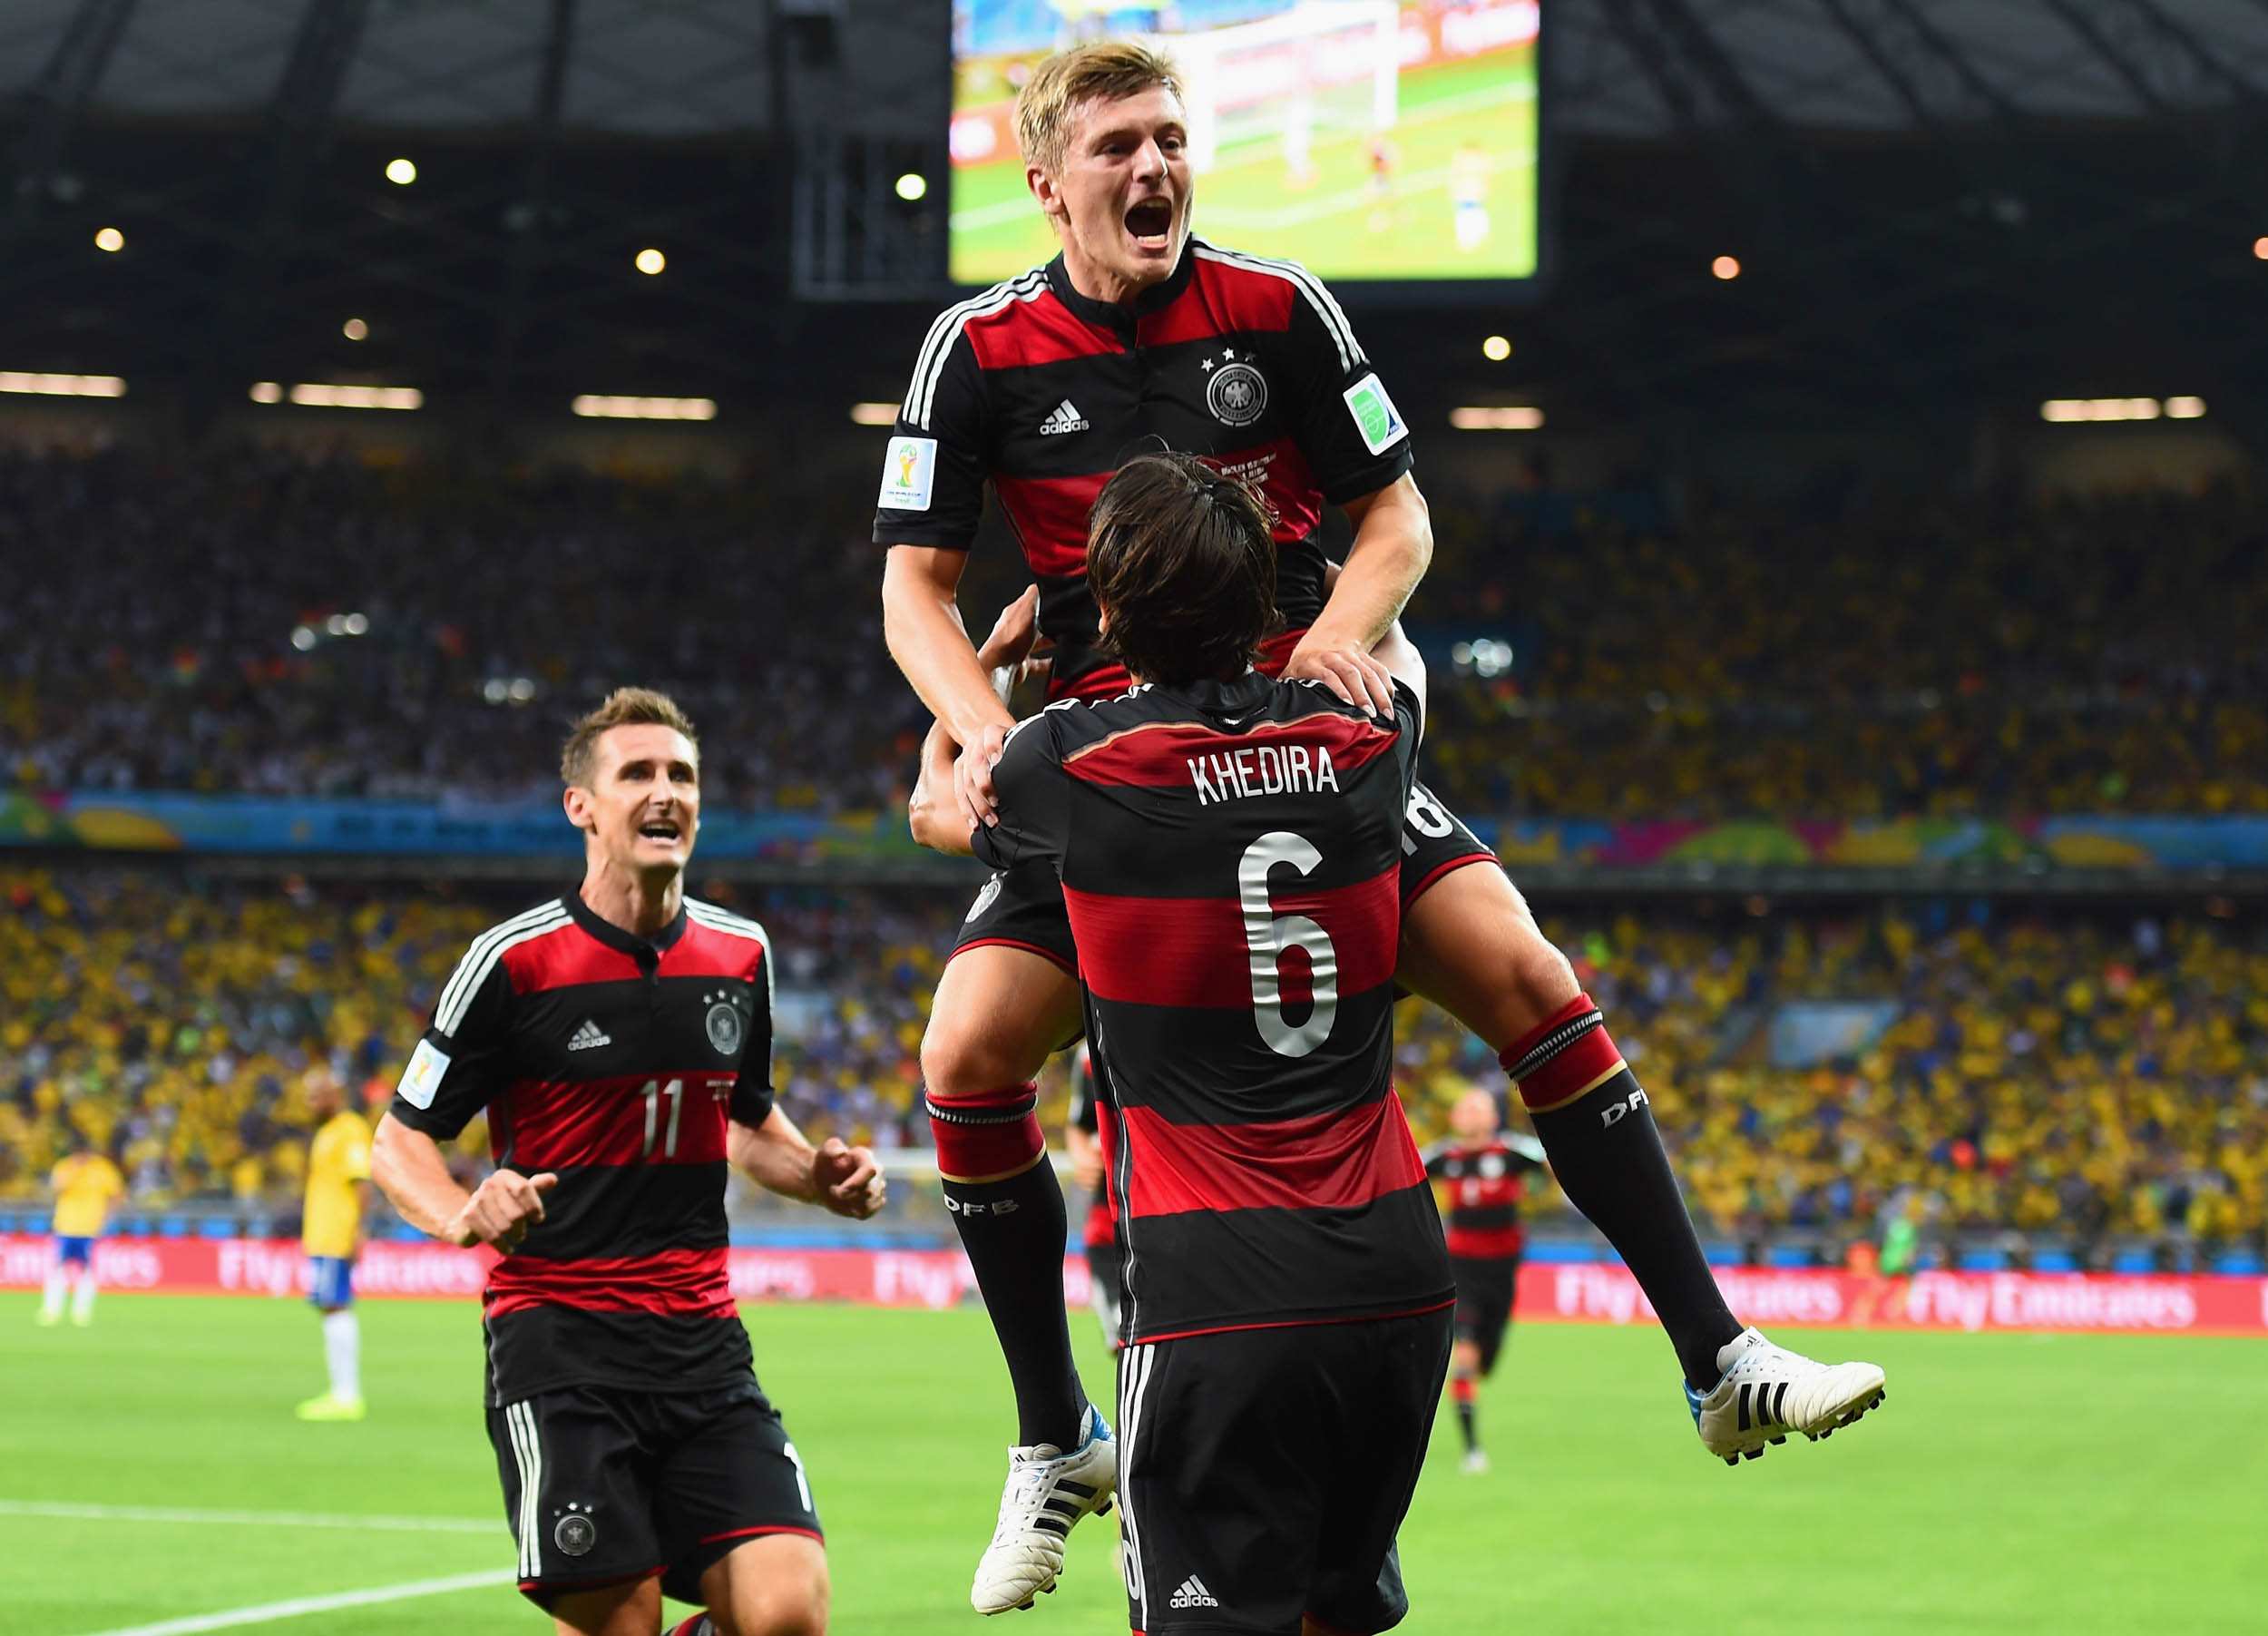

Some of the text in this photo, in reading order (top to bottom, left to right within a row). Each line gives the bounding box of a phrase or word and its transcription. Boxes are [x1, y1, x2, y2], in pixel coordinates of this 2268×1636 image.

[1039, 418, 1090, 436] adidas
[1187, 746, 1340, 806] KHEDIRA
[1402, 786, 1453, 857] 8
[1238, 831, 1338, 1058] 6
[567, 1035, 611, 1051] adidas
[640, 1079, 682, 1158] 11
[943, 1193, 1019, 1216] DFB
[1907, 1270, 1987, 1331] Fly
[1993, 1271, 2196, 1327] Emirates
[1169, 1594, 1218, 1609] adidas
